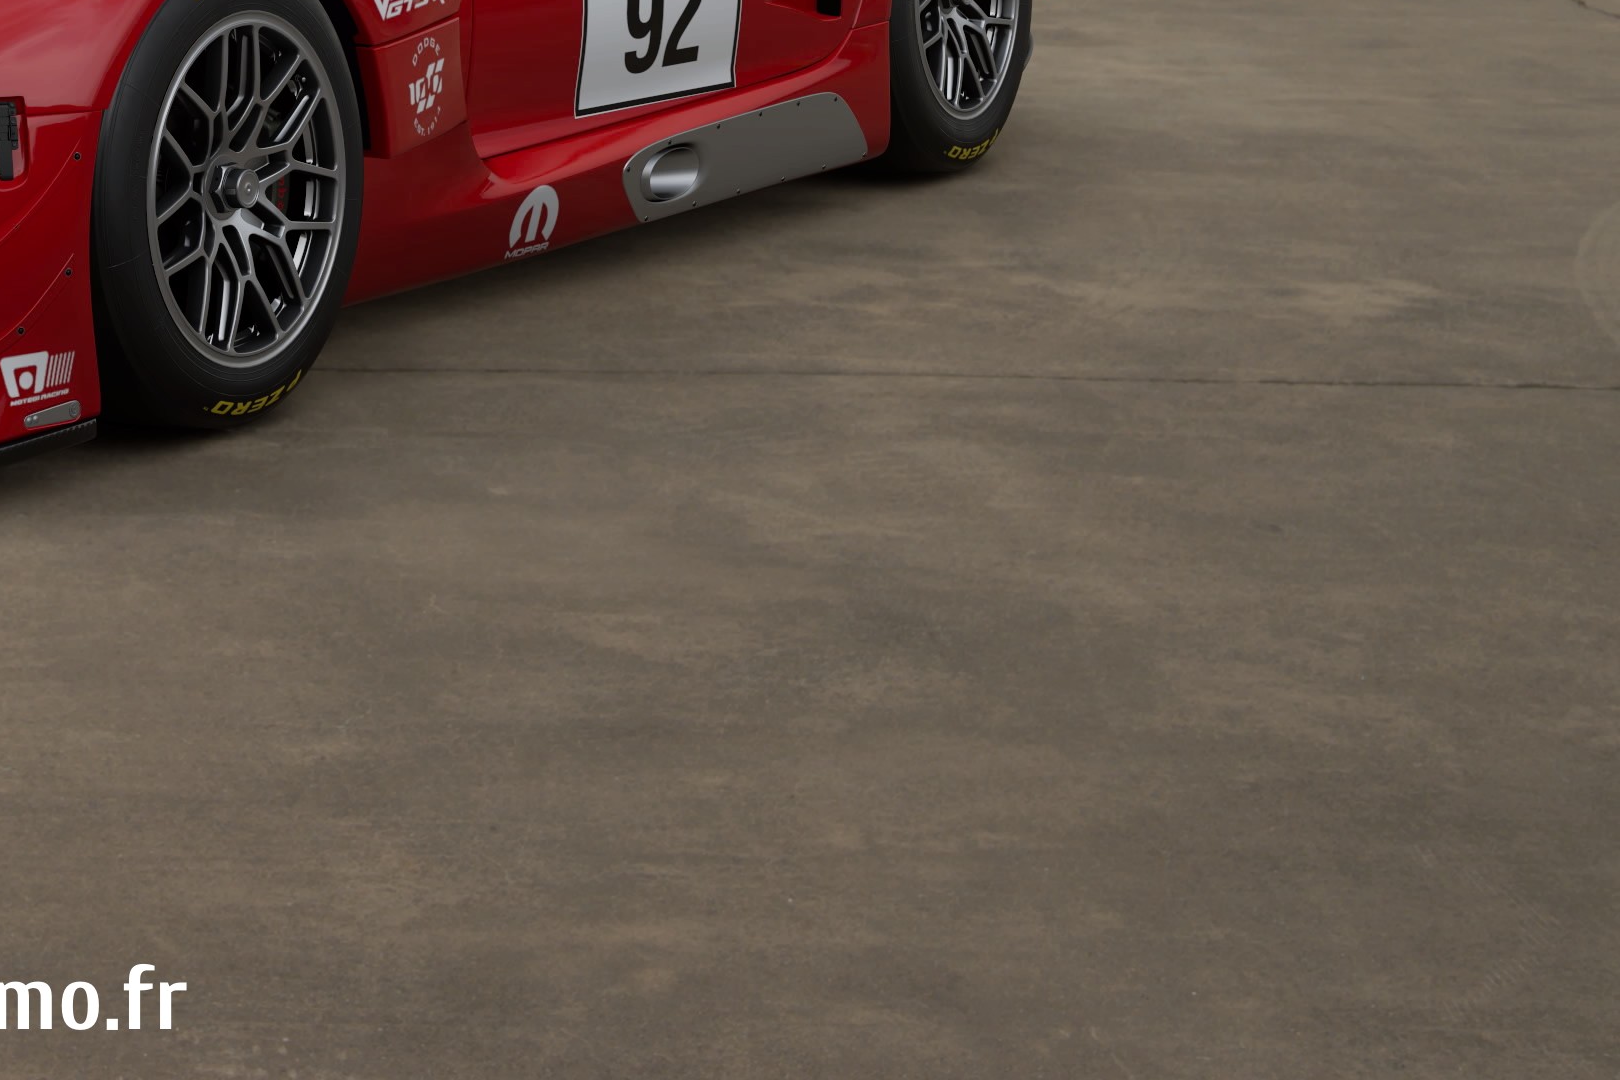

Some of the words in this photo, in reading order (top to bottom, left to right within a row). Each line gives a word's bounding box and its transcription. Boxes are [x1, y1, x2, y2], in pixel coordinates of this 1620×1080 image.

[412, 37, 441, 67] DODGE
[504, 241, 549, 260] MOPAR
[41, 388, 70, 400] RACING
